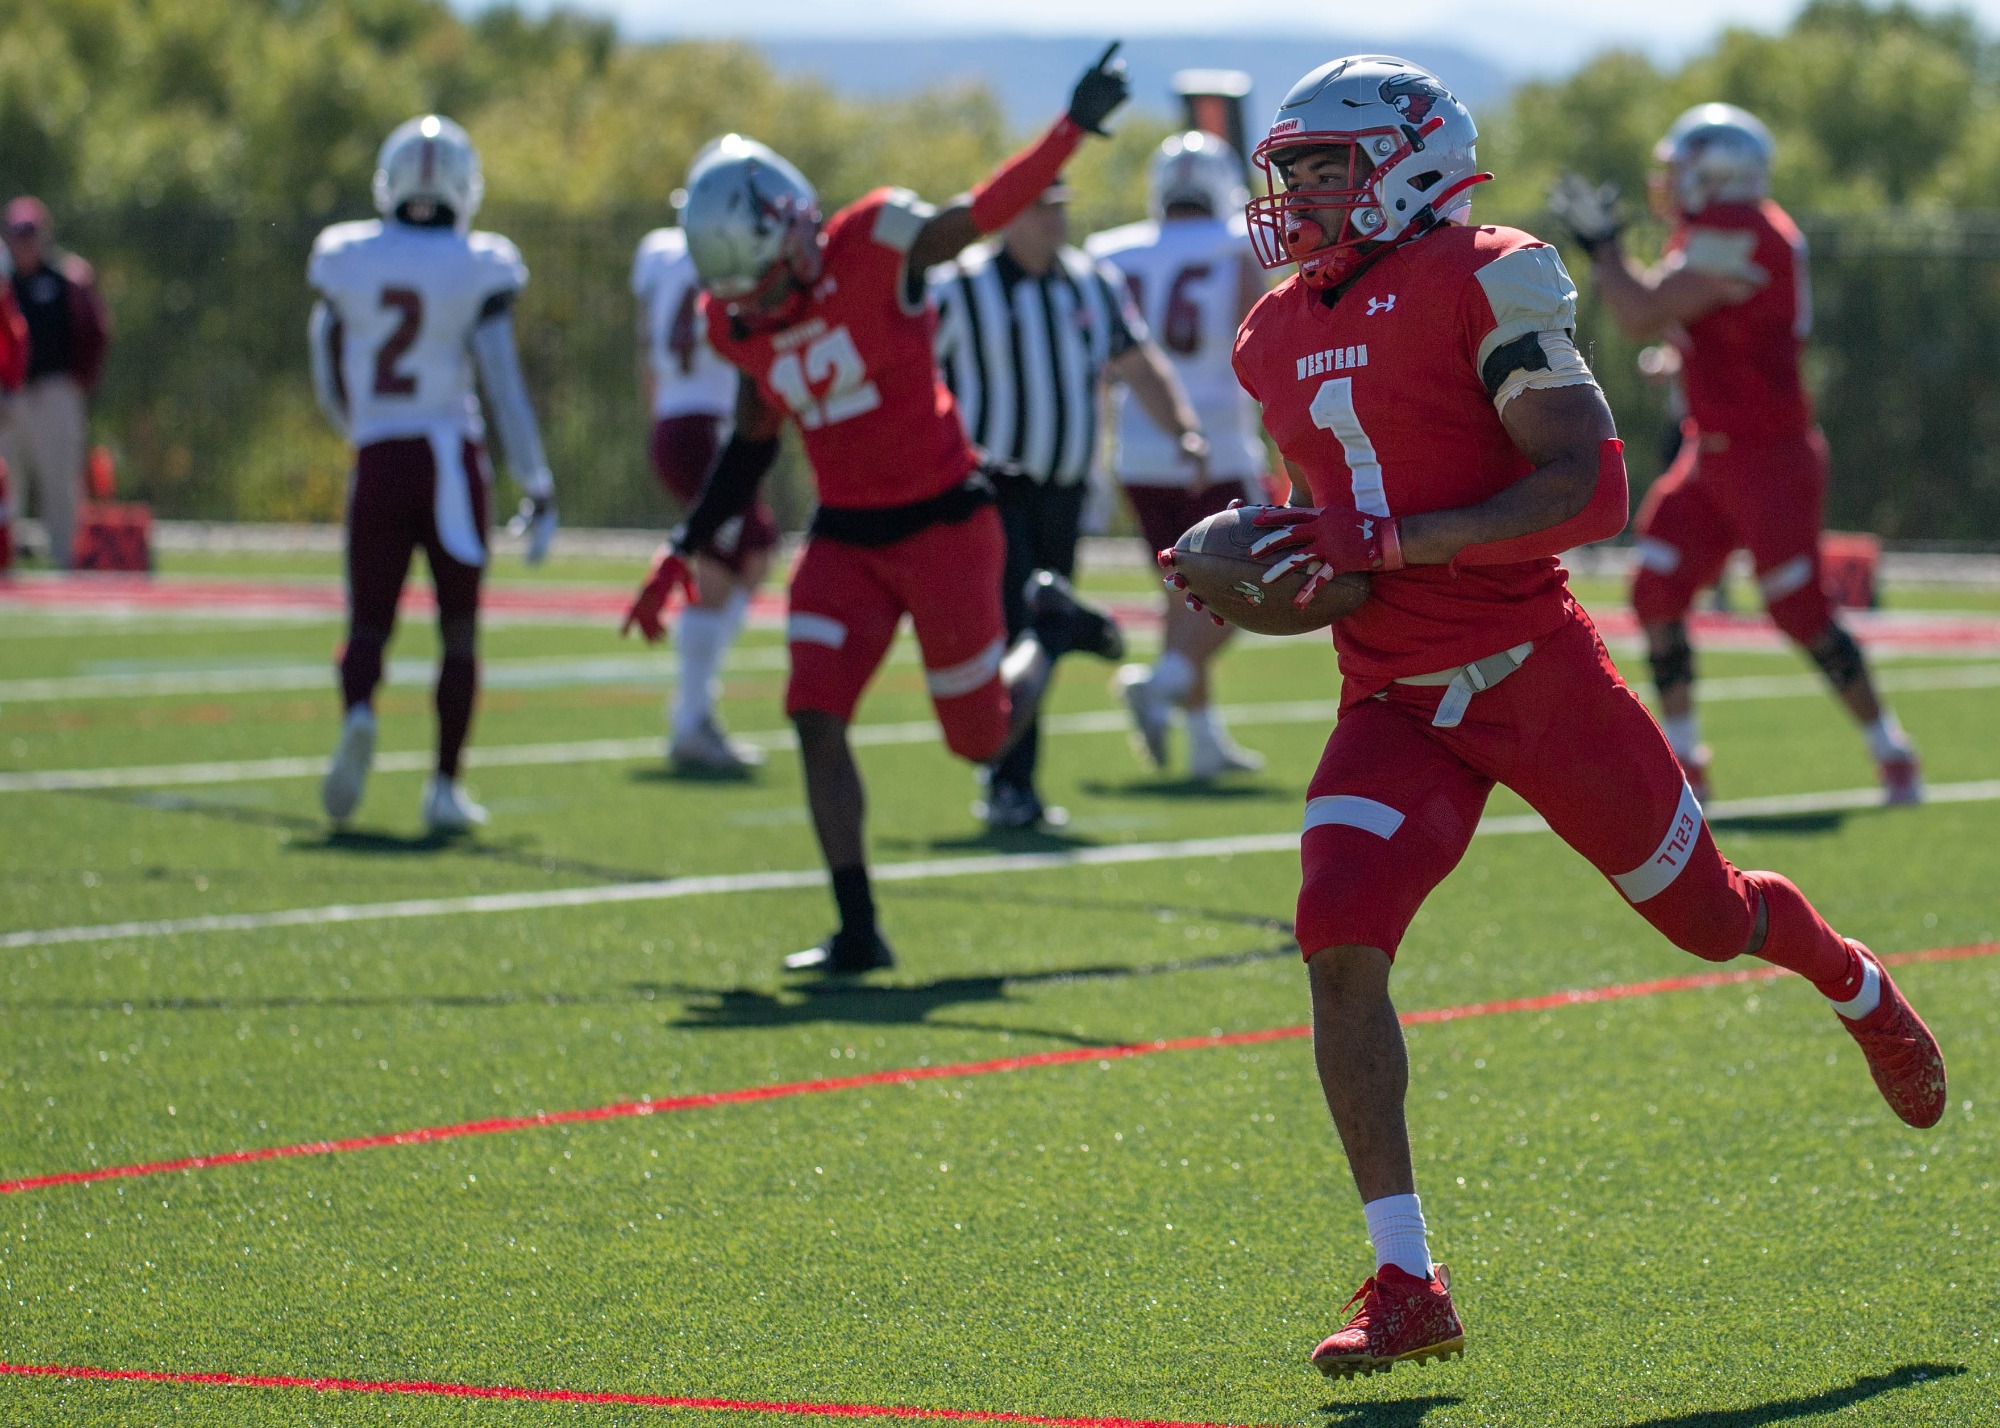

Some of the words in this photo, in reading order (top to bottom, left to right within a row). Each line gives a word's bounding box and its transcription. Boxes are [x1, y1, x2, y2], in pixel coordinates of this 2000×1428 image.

[375, 285, 424, 396] 2
[768, 325, 882, 430] 12
[1296, 344, 1370, 381] WESTERN
[1308, 376, 1391, 518] 1
